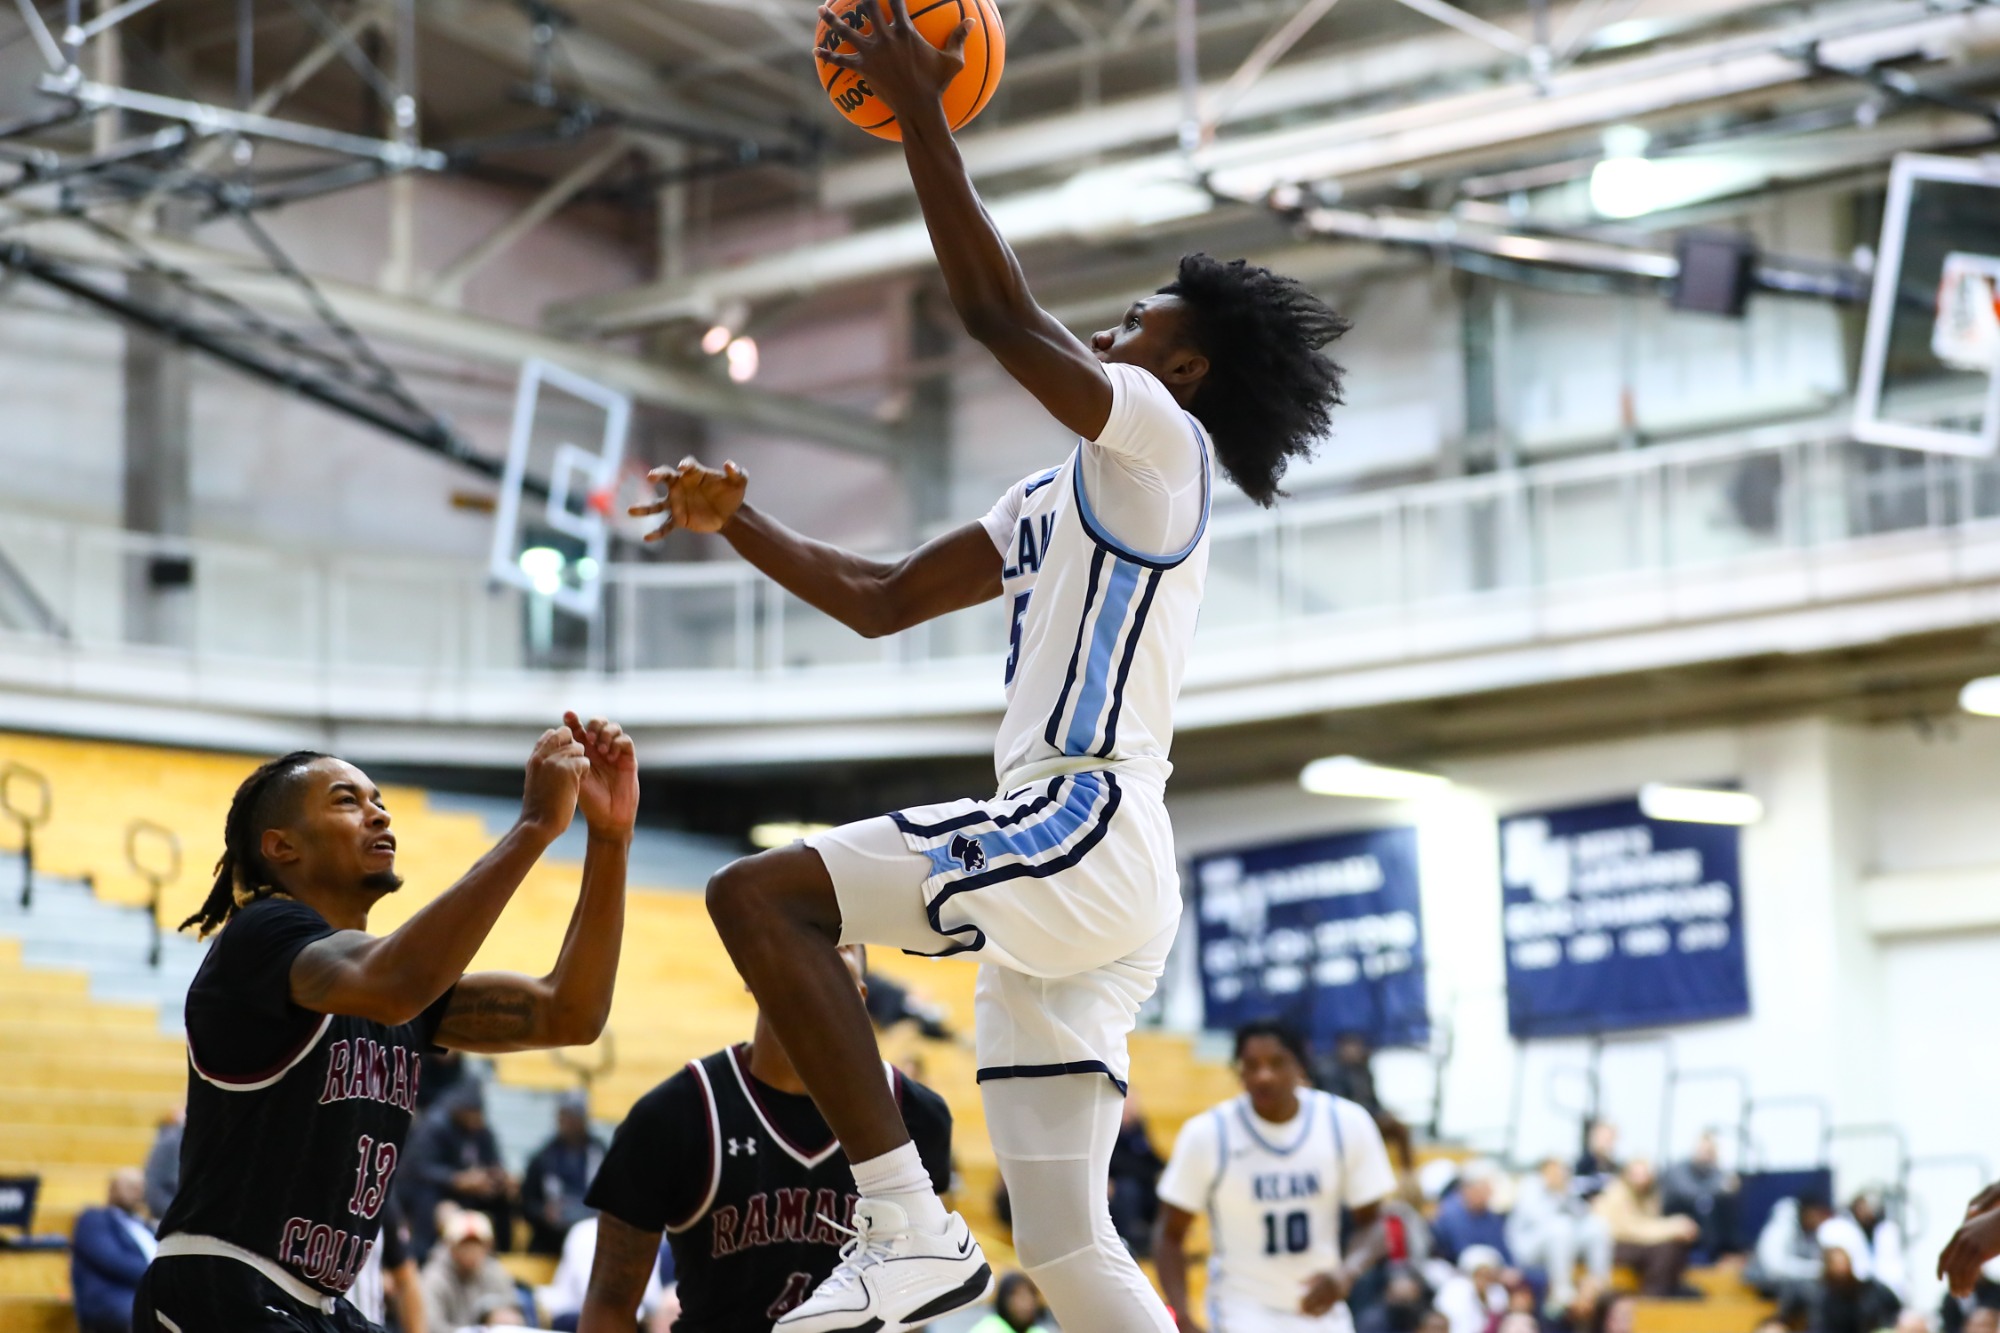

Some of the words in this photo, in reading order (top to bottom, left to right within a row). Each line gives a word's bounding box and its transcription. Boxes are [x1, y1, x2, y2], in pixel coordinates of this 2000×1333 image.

[1004, 588, 1034, 688] 5
[348, 1134, 398, 1220] 13
[1254, 1169, 1320, 1201] KEAN
[1263, 1210, 1310, 1257] 10
